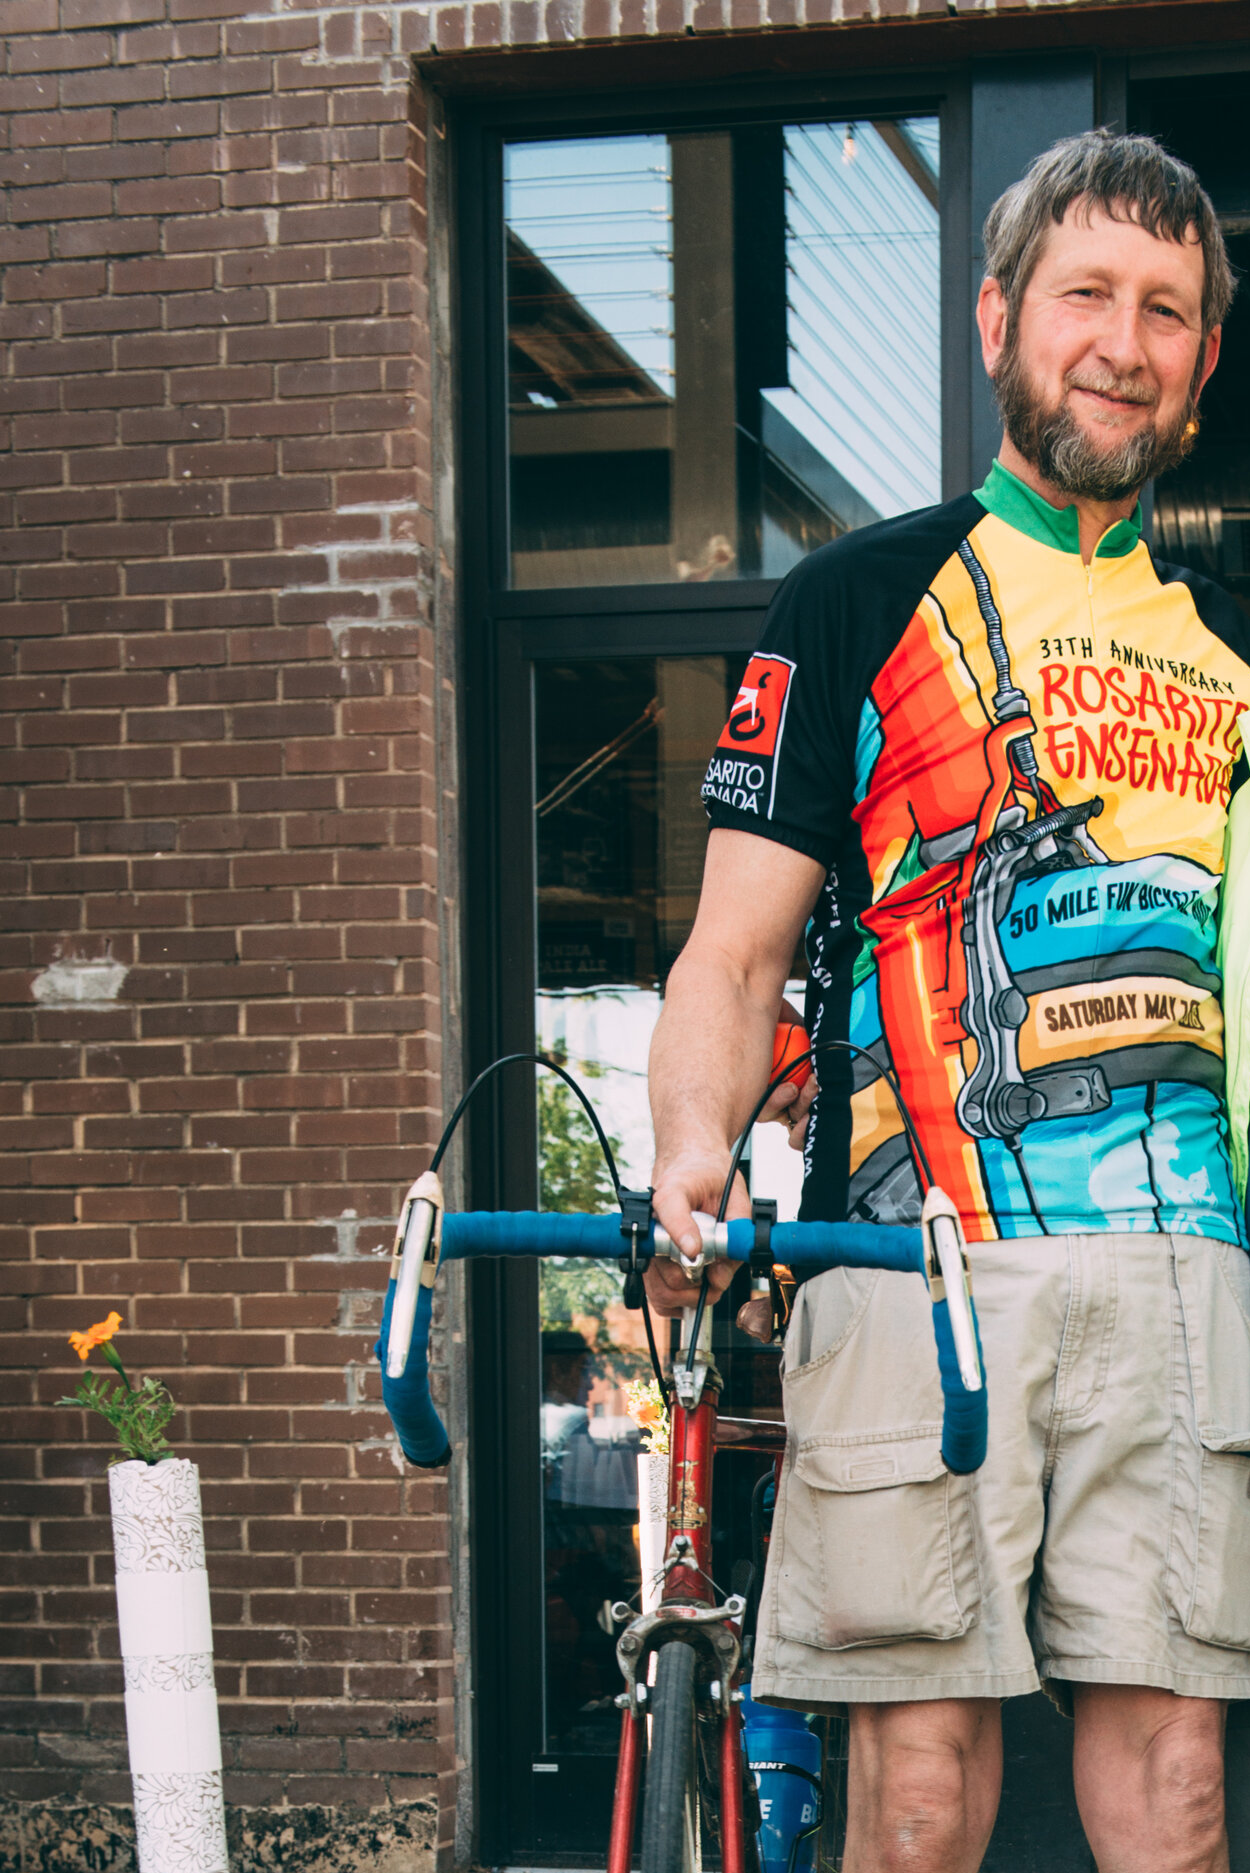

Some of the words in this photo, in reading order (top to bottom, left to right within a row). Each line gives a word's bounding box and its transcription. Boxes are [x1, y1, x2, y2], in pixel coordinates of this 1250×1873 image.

[1040, 637, 1093, 659] 37TH
[1110, 639, 1235, 694] ANNIVERSARY
[1009, 903, 1038, 939] 50
[1047, 887, 1098, 926] MILE
[540, 959, 573, 973] ALE
[1044, 994, 1137, 1032] SATURDAY
[1144, 993, 1176, 1021] MAY
